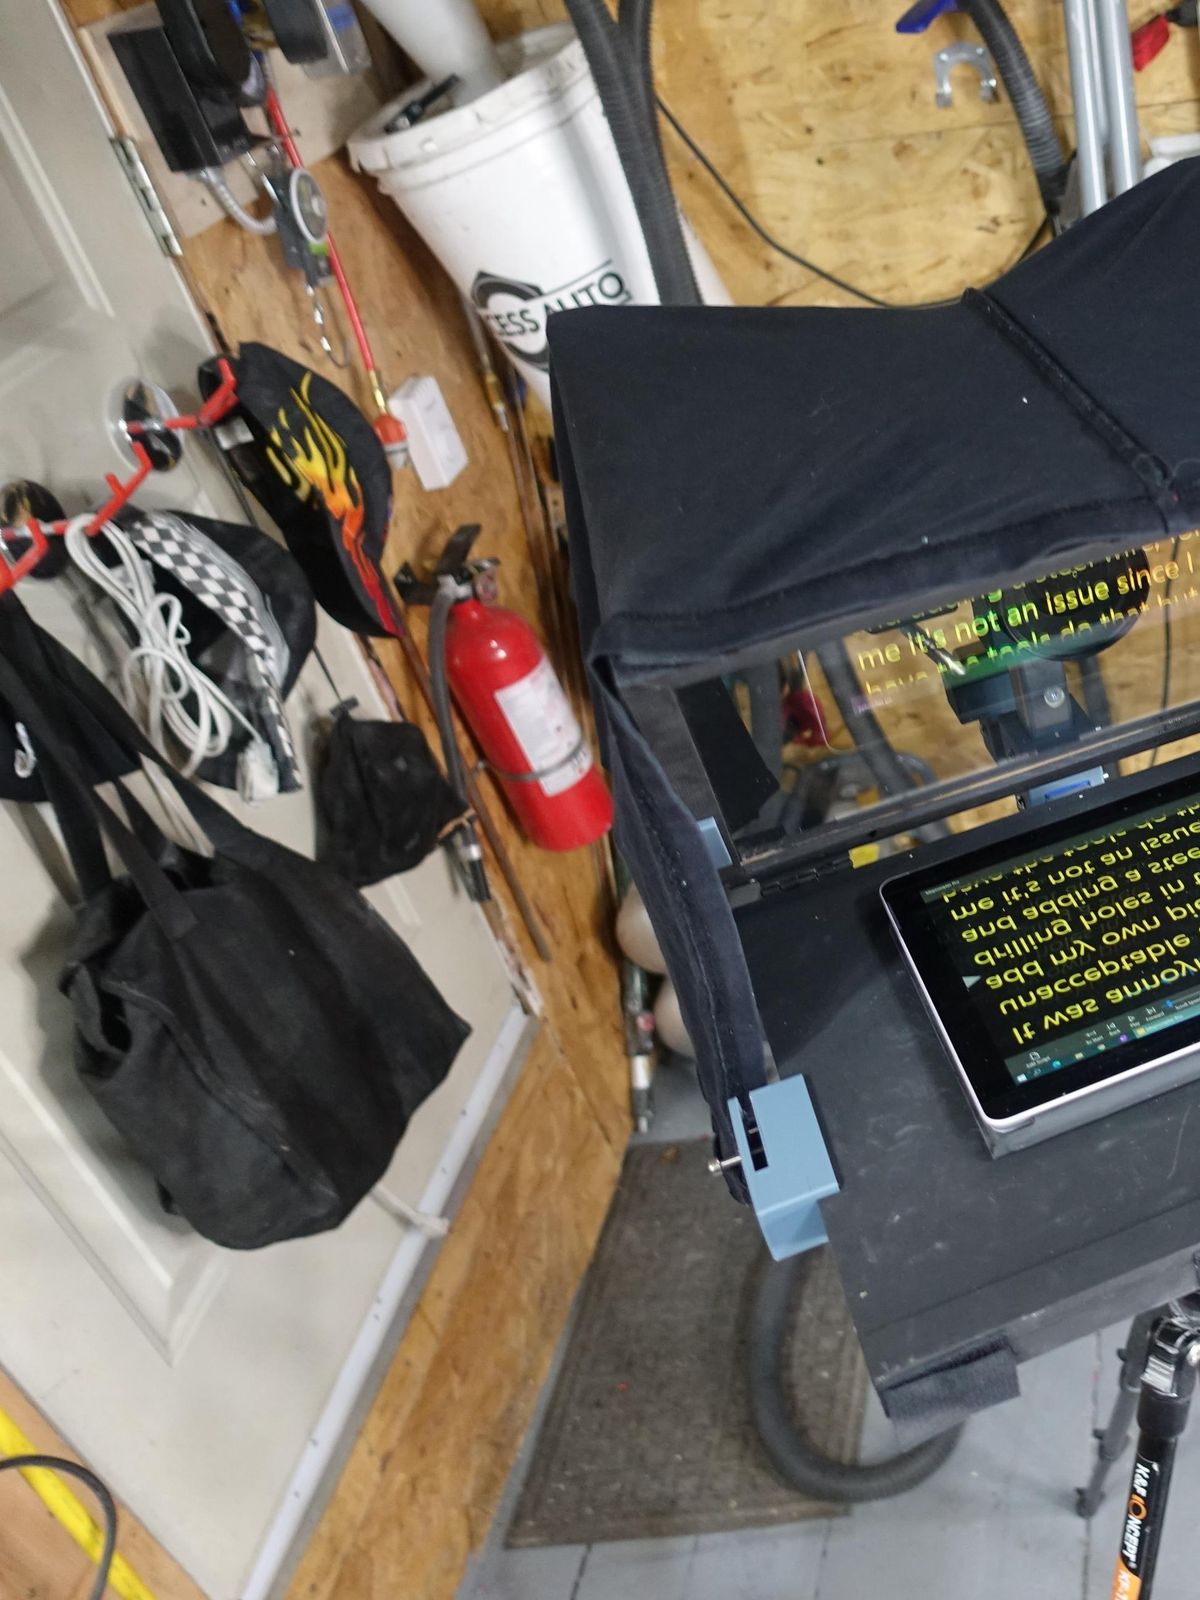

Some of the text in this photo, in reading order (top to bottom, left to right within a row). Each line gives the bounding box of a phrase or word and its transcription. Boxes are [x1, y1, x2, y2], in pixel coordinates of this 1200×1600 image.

[857, 641, 902, 673] me
[954, 610, 1002, 643] not
[1007, 601, 1040, 627] an
[1044, 579, 1110, 617] issue
[1116, 560, 1180, 596] since
